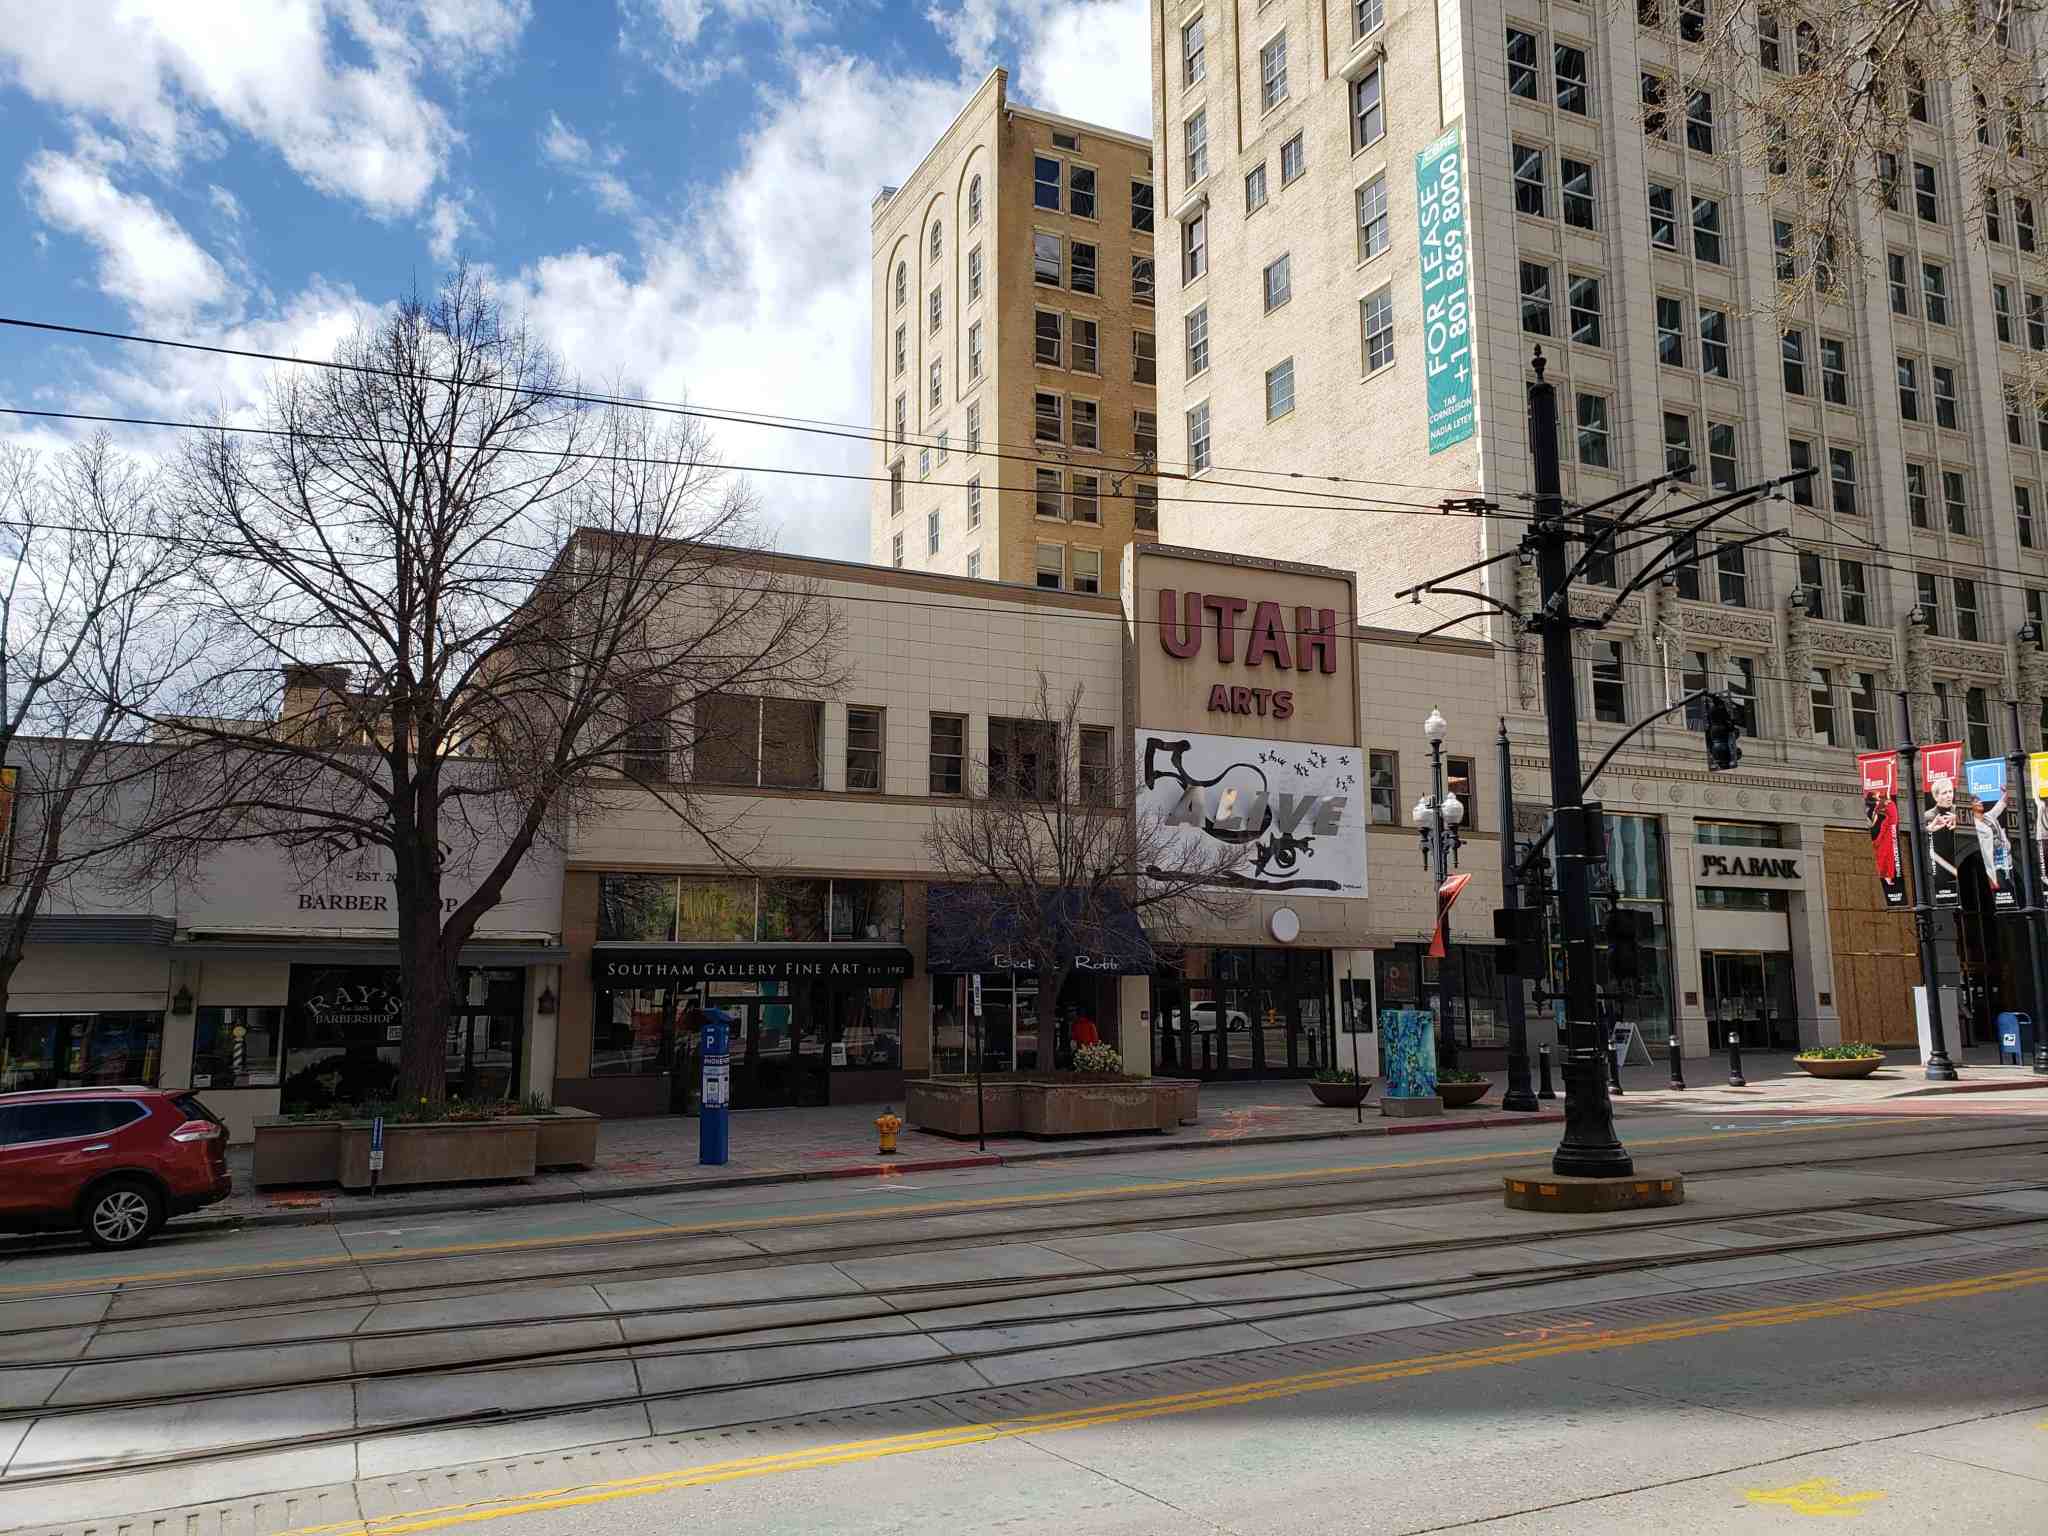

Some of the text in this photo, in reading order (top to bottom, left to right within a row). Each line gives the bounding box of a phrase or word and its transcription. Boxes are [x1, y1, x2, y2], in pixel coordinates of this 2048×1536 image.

[1439, 153, 1460, 223] 8000
[1421, 181, 1448, 378] FOR LEASE
[1444, 229, 1464, 281] 869
[1448, 287, 1468, 339] 801
[1159, 589, 1337, 674] UTAH
[1207, 684, 1294, 719] ARTS
[1165, 784, 1348, 836] ALIVE
[298, 894, 388, 911] BARBER
[607, 962, 695, 976] SOUTHAM
[704, 962, 777, 976] GALLERY
[785, 962, 823, 976] FINE
[830, 961, 860, 975] ART
[314, 1015, 394, 1024] BARBERSHOP
